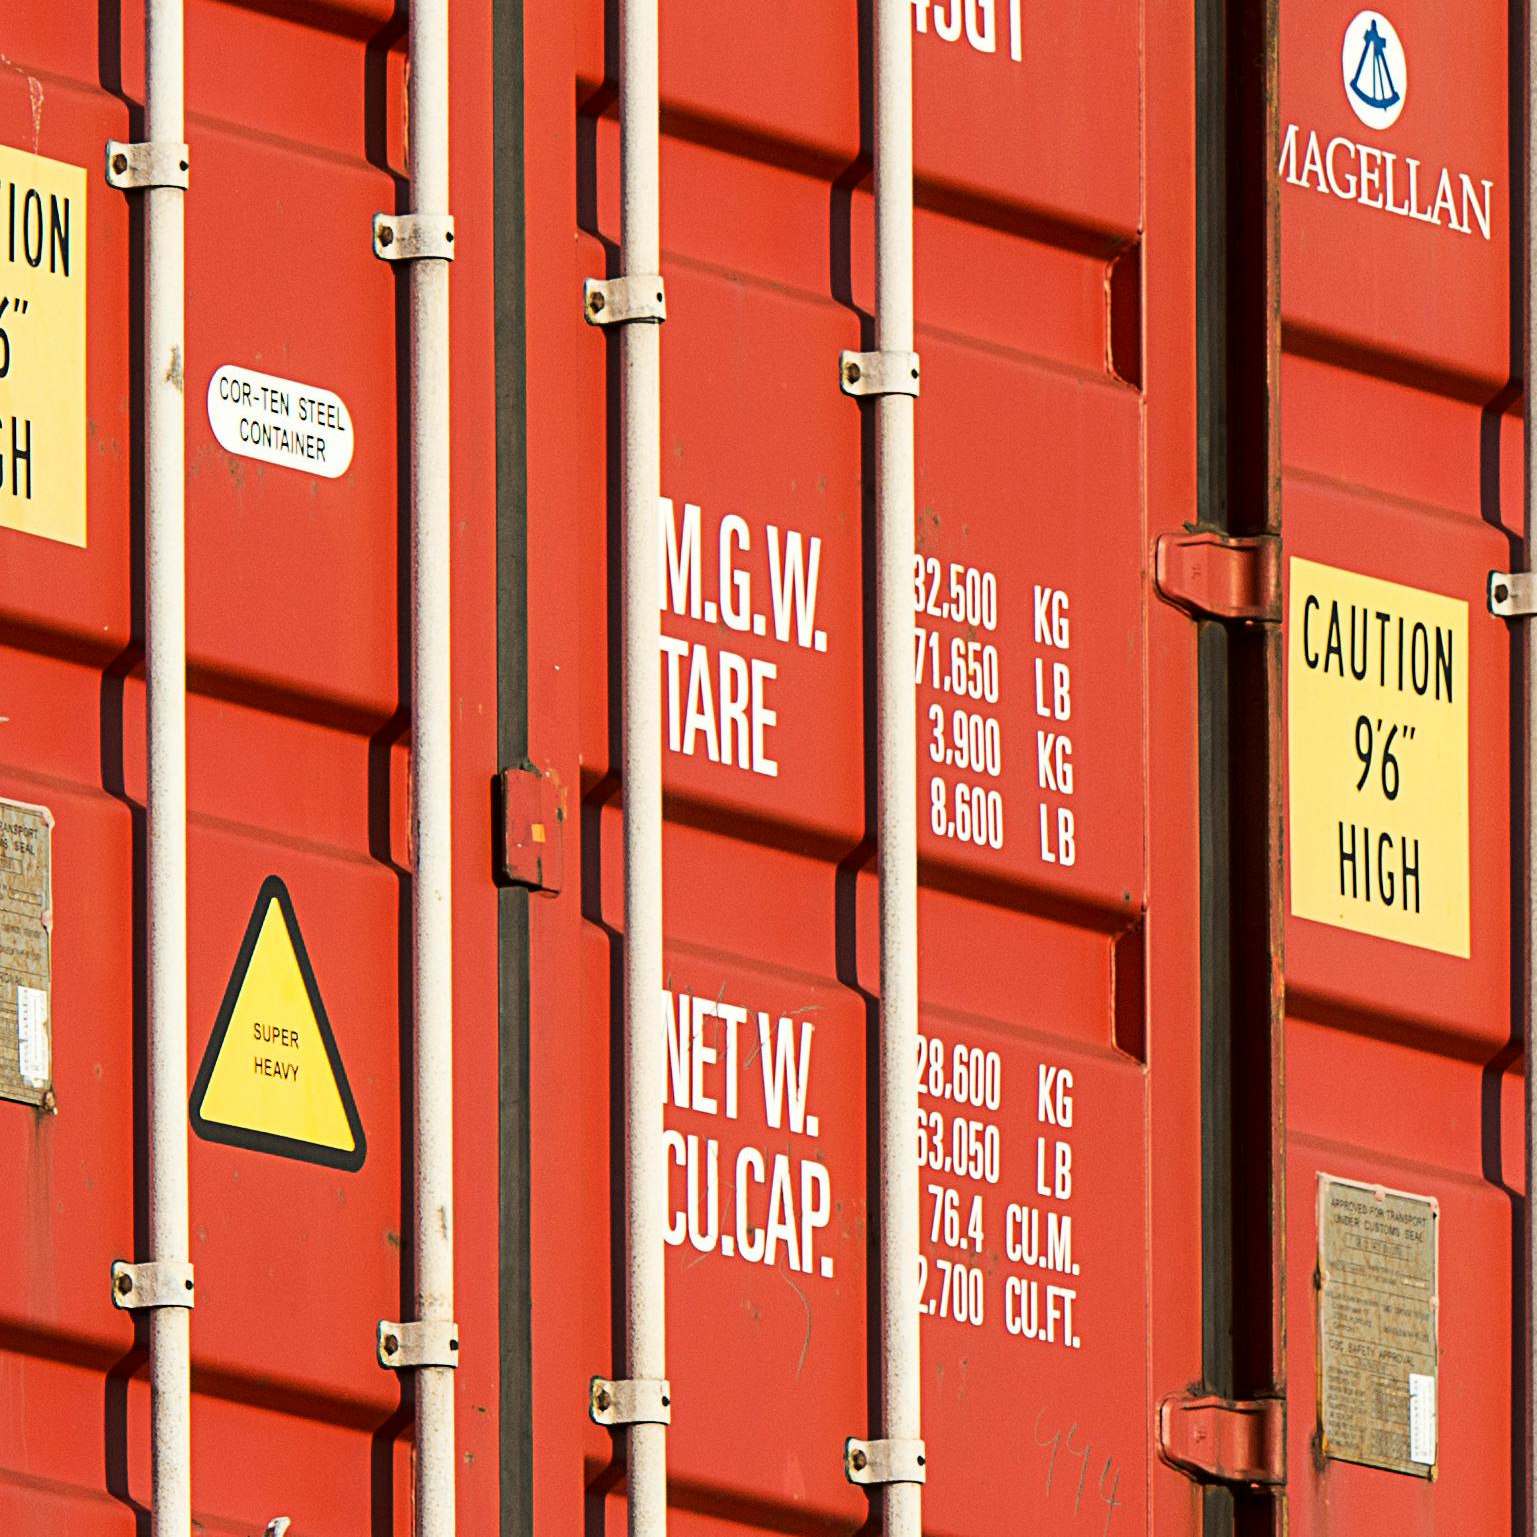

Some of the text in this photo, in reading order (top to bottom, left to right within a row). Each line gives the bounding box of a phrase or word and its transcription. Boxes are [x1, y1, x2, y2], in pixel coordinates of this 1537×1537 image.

[218, 375, 347, 432] COR-TEN STEEL
[238, 417, 327, 463] CONTAINER
[659, 496, 828, 654] M.G.W.
[1033, 584, 1070, 649] KG
[1303, 593, 1454, 704] CAUTION
[659, 634, 778, 778] TARE
[1034, 657, 1071, 721] LB
[928, 703, 1075, 796] 3,900 KG
[930, 776, 1076, 867] 8,600 LB
[1338, 820, 1421, 915] HIGH
[252, 1021, 301, 1050] SUPER
[253, 1055, 300, 1083] HEAVY
[662, 988, 820, 1139] NET W.
[1037, 1063, 1074, 1129] KG
[662, 1129, 834, 1279] CU.CAP.
[1036, 1136, 1073, 1200] LB
[927, 1183, 1081, 1277] 76.4 CU.M.
[1004, 1275, 1082, 1349] CU.FT.
